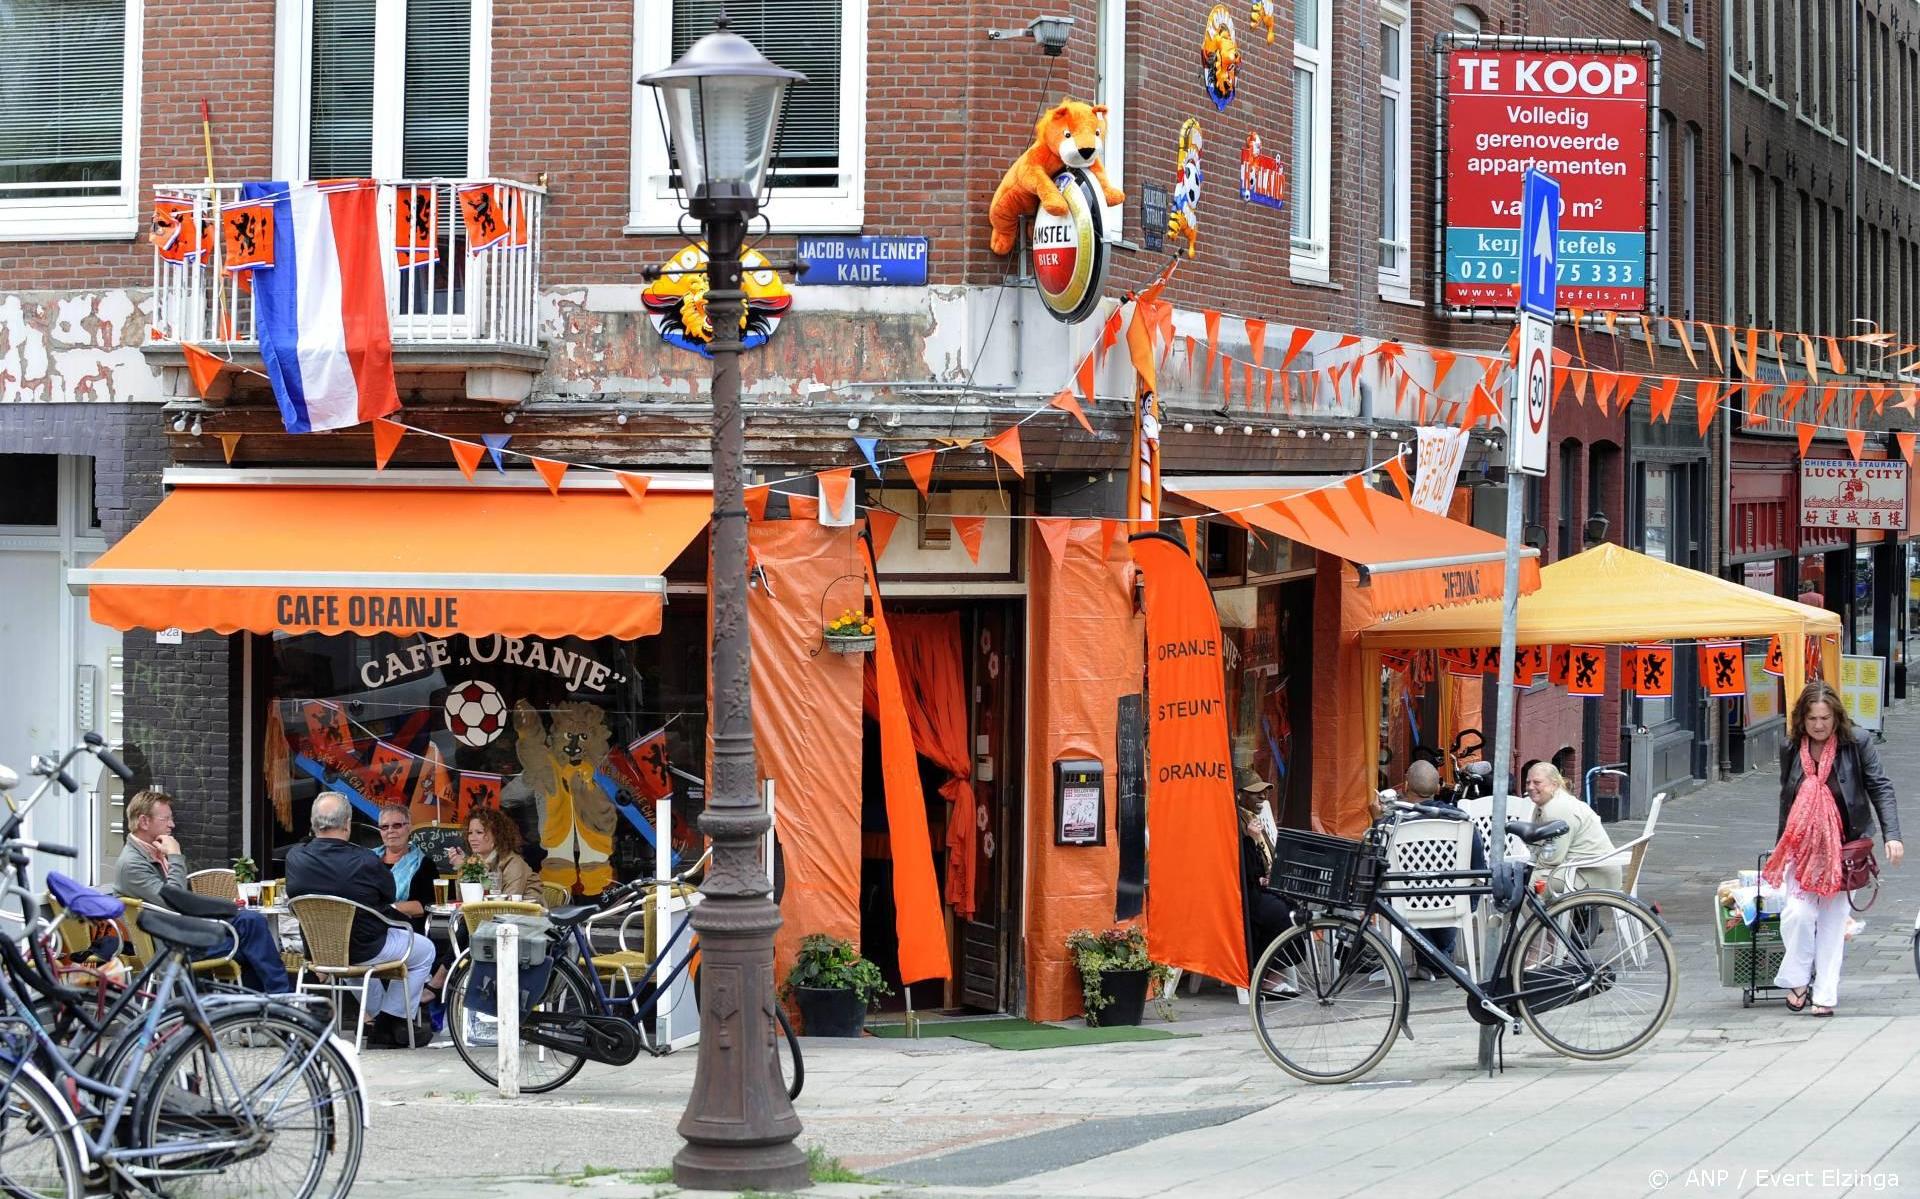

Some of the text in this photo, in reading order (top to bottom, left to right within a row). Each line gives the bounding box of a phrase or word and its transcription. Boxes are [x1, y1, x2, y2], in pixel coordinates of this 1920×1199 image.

[1458, 58, 1638, 95] TE KOOP
[1506, 105, 1589, 129] Volledig
[1476, 132, 1619, 151] gerenoveerde
[1467, 156, 1627, 175] appartementen
[1034, 225, 1071, 244] AMSTEL
[800, 242, 926, 260] JACOB VAN LENNEP
[1558, 236, 1616, 255] tefels
[1038, 253, 1059, 266] BIER
[838, 263, 887, 282] KADE.
[1461, 261, 1503, 279] 020
[1531, 374, 1544, 409] 30
[1804, 468, 1904, 479] LUCKY CITY
[277, 594, 458, 628] CAFE ORANJE
[1158, 639, 1217, 661] ORANJE
[1158, 698, 1221, 721] STEUNT
[1159, 760, 1227, 783] ORANJE
